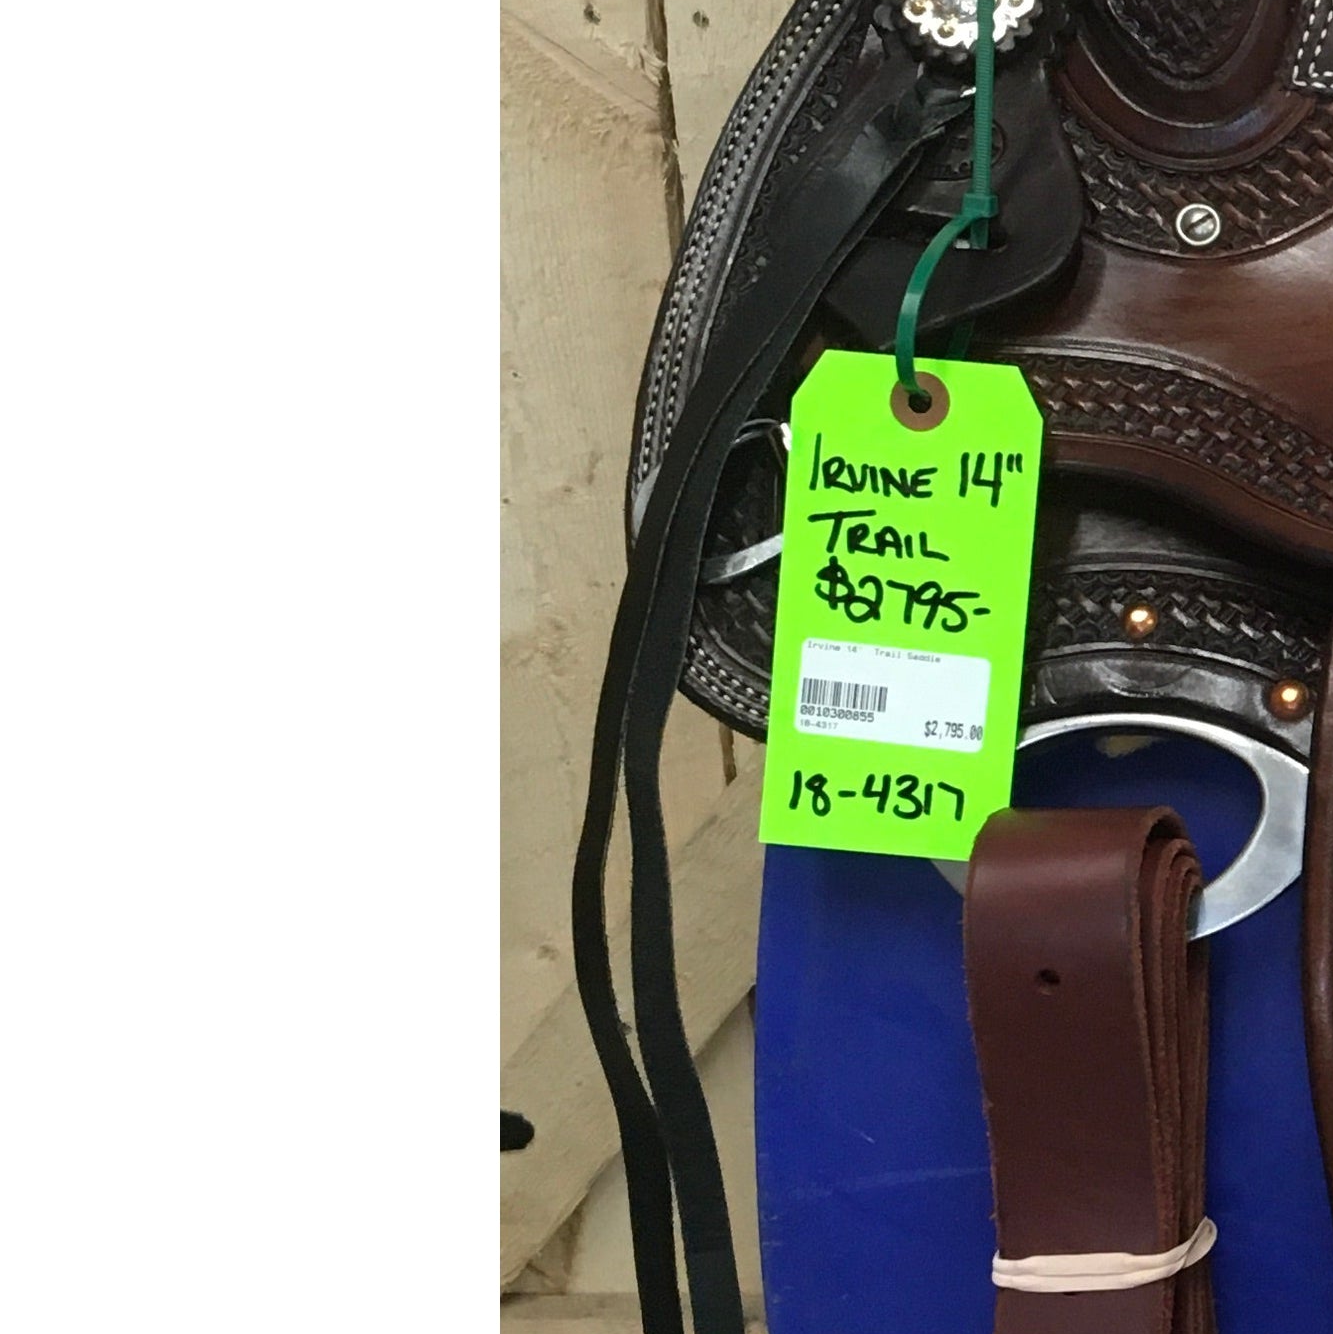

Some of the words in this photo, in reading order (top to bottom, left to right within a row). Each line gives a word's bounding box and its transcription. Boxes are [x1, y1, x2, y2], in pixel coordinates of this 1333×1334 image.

[808, 434, 938, 499] IRVINE
[807, 509, 950, 562] TRAIL
[807, 640, 841, 652] Irvine
[874, 648, 902, 660] Trail
[800, 704, 876, 724] 0010300855
[924, 720, 984, 742] $2,795.00
[788, 770, 966, 820] 18-4317
